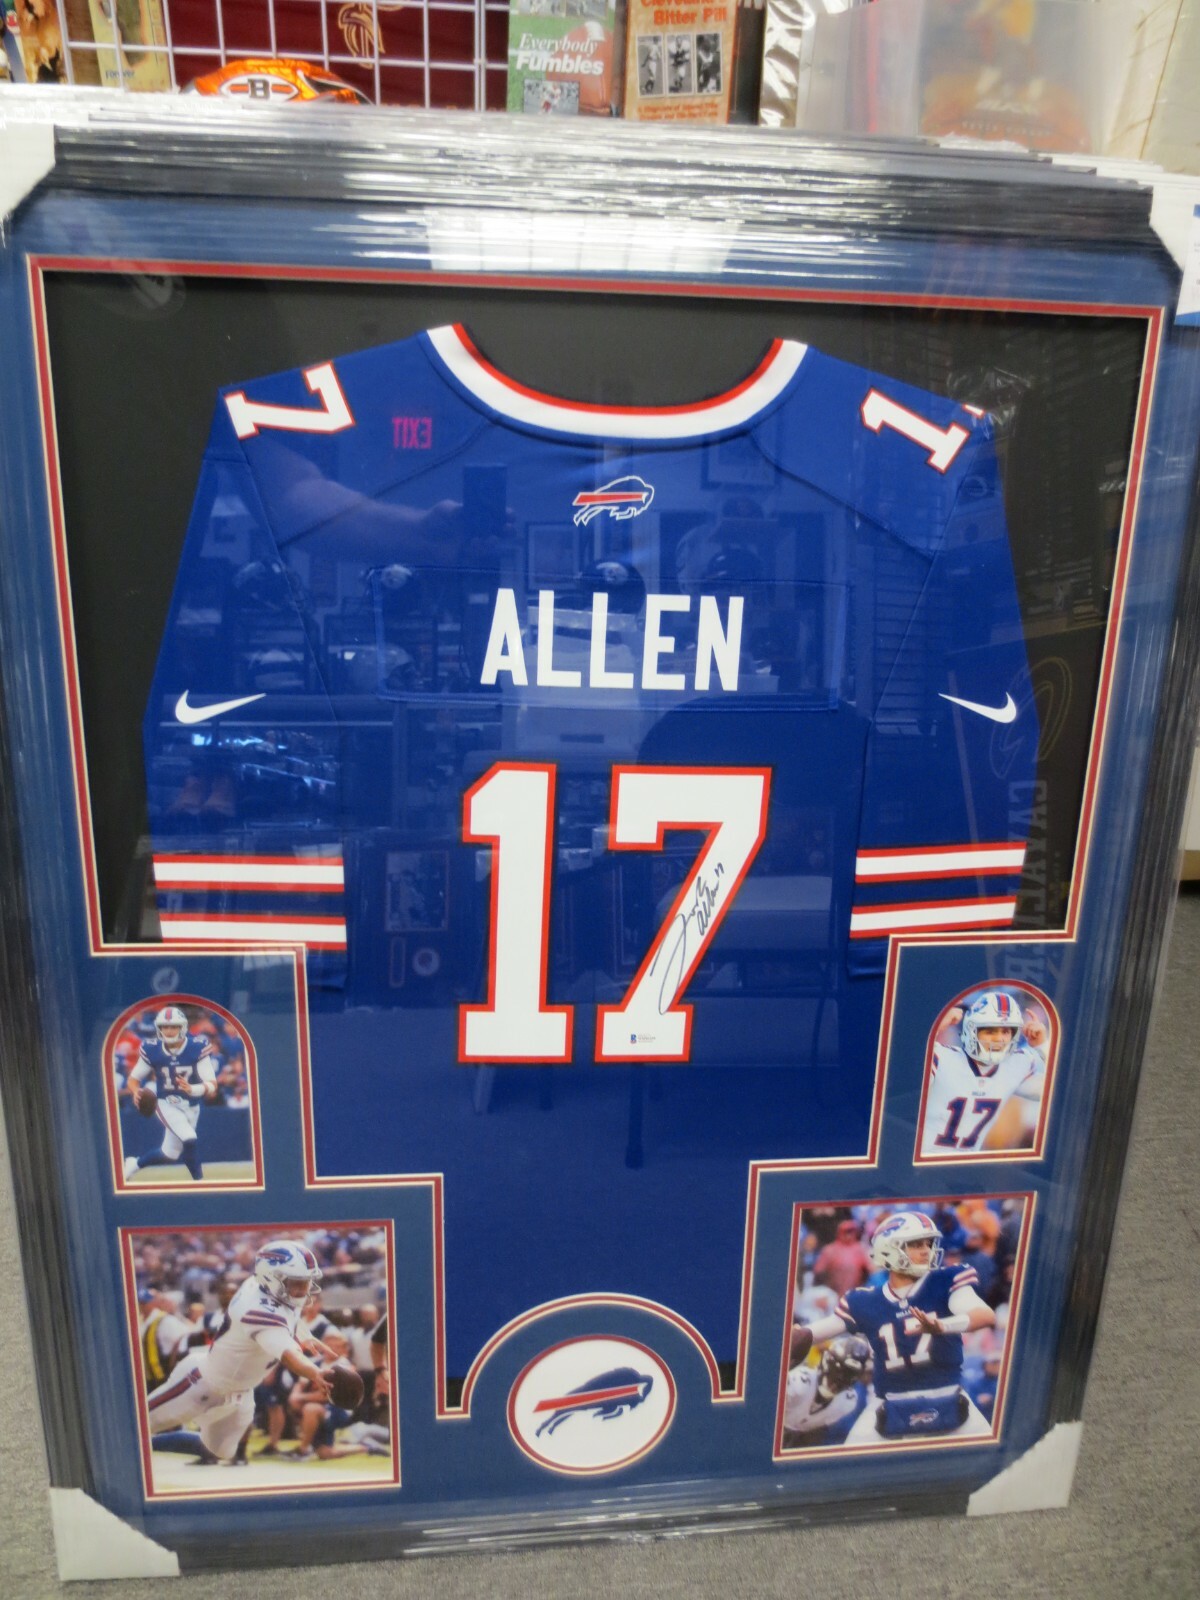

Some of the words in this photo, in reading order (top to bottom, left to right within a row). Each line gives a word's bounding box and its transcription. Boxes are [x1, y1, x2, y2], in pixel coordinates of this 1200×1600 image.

[654, 10, 697, 25] Bitter
[703, 7, 727, 23] Pill
[516, 51, 604, 76] Fumbles
[519, 32, 598, 57] Everybody
[480, 587, 744, 691] ALLEN
[457, 760, 773, 1063] 17
[933, 1096, 1003, 1149] 17
[877, 1310, 938, 1370] 17
